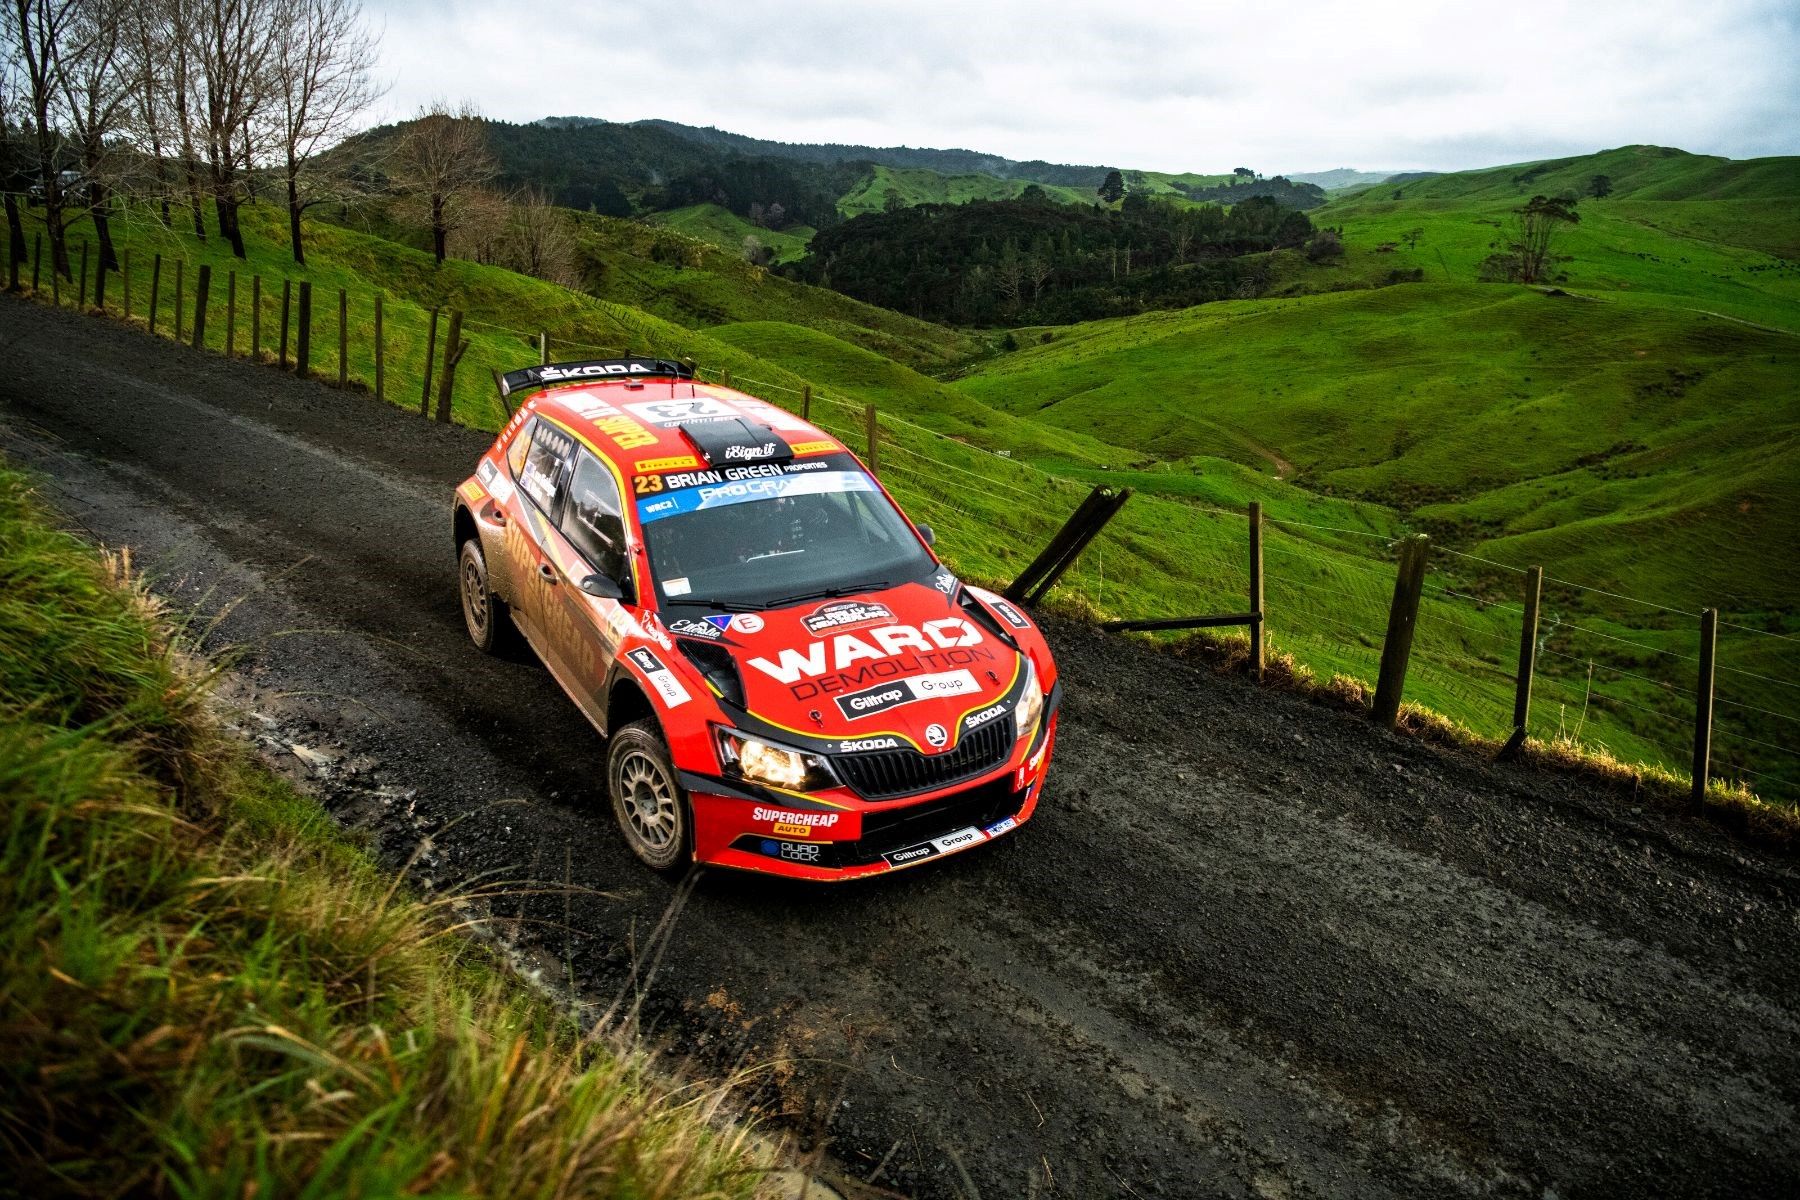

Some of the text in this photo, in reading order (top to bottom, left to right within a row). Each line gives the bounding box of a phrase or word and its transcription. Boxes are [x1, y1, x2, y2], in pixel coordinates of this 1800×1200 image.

[539, 363, 650, 380] ŠKODA
[634, 461, 828, 494] 23 BRIAN GREEN PROPERTIES
[645, 500, 673, 513] WRC2
[738, 617, 758, 630] E
[745, 617, 984, 684] WARD
[790, 647, 996, 701] DEMOLITION
[850, 678, 964, 711] Giltrap Group
[965, 704, 1007, 729] ŠKODA
[840, 738, 899, 752] ŠKODA
[752, 806, 839, 828] SUPERCHEAP
[777, 825, 807, 834] AUTO
[781, 842, 819, 854] QUAD
[781, 850, 819, 862] LOCK
[893, 832, 974, 862] Giltrap Group
